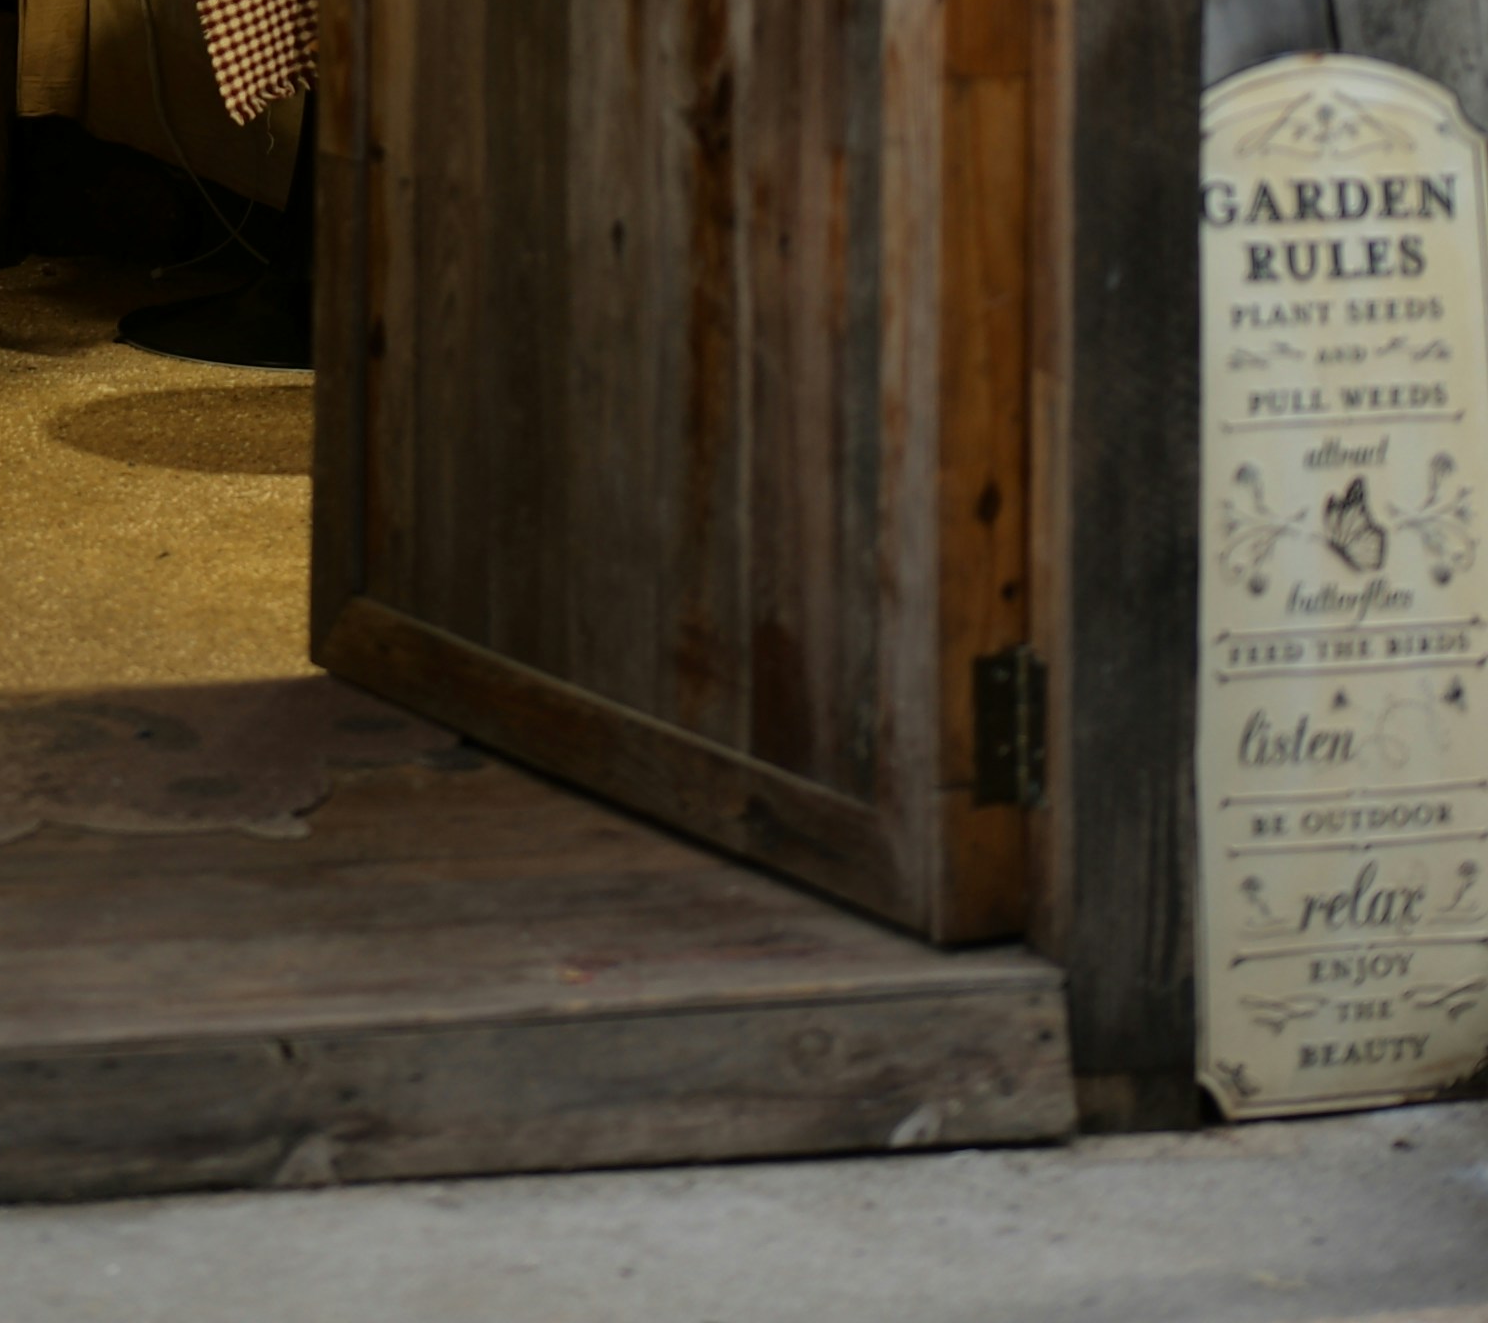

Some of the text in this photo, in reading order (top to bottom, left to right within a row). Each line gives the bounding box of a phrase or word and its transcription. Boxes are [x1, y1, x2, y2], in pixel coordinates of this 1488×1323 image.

[1201, 173, 1458, 227] GARDEN
[1245, 235, 1427, 283] RULES
[1230, 295, 1445, 330] PLANT SEEDS
[1315, 345, 1368, 366] AND
[1247, 382, 1449, 415] PULL WEEDS
[1304, 435, 1390, 471] attract
[1285, 577, 1415, 628] butterflies
[1228, 632, 1471, 665] FEED THE BIRDS
[1238, 708, 1357, 770] listen
[1251, 802, 1453, 837] BE OUTDOOR
[1297, 859, 1426, 935] relax
[1308, 952, 1415, 987] ENJOY
[1336, 999, 1394, 1024] THE
[1298, 1034, 1430, 1070] BEAUTY
